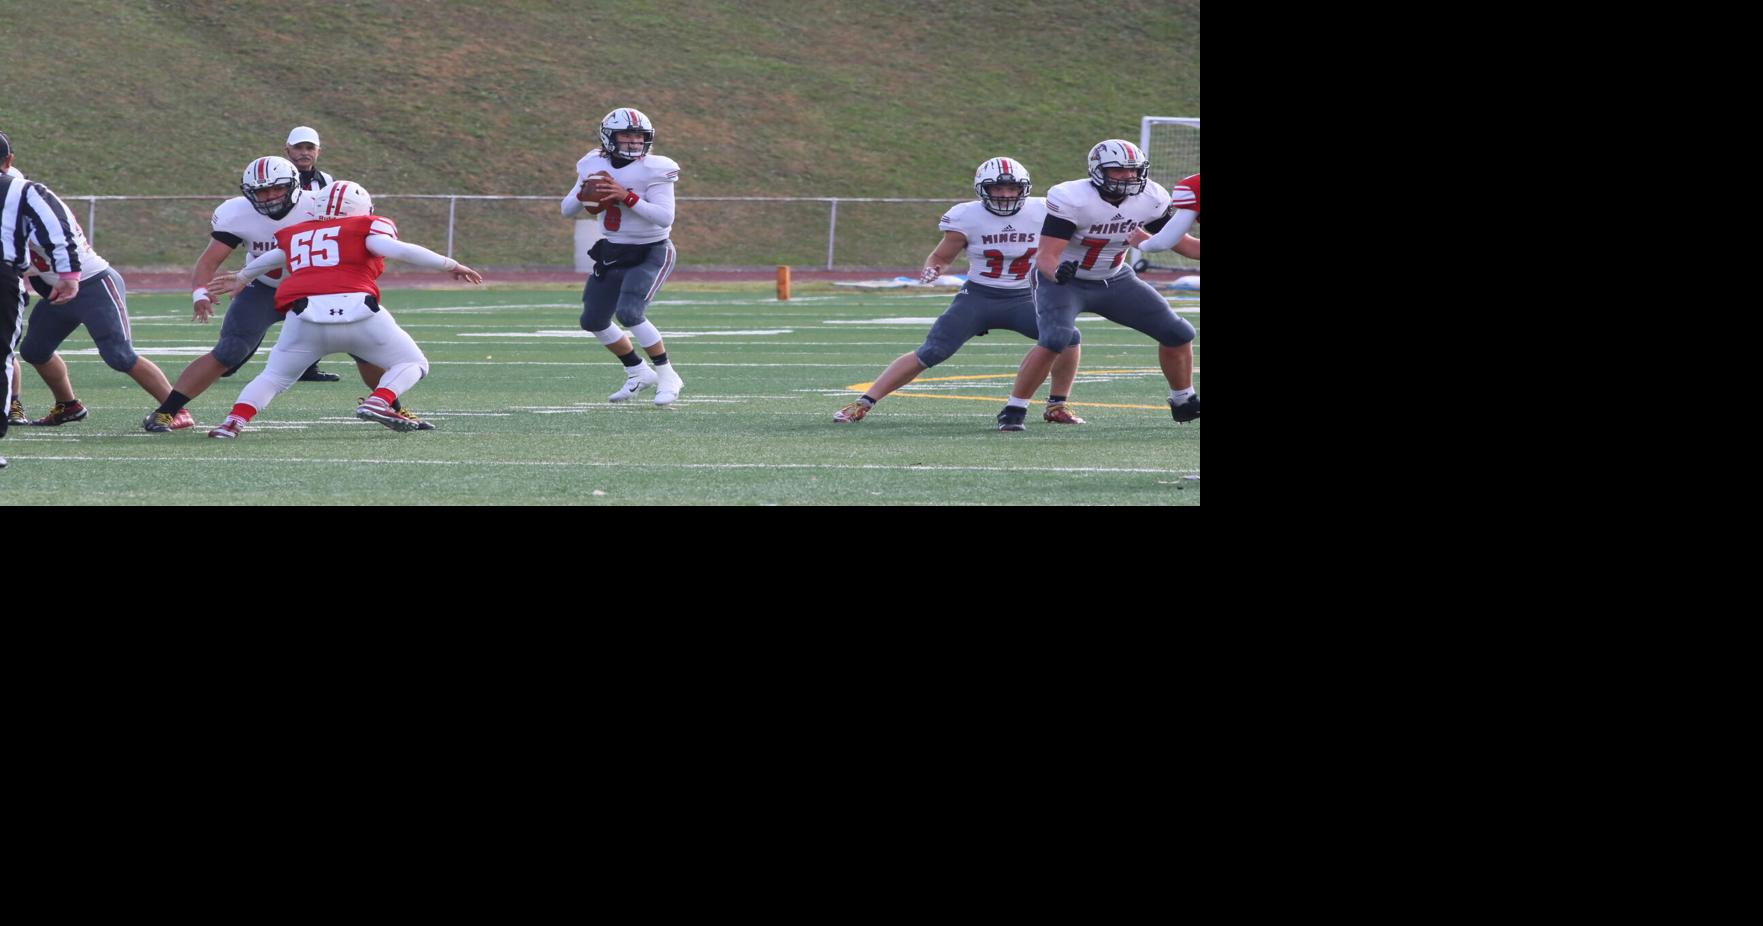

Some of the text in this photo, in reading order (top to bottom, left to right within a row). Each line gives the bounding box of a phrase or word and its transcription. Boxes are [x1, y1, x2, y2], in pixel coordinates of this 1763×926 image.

[290, 226, 341, 272] 55
[981, 233, 1035, 244] MINERS
[980, 247, 1038, 280] 34
